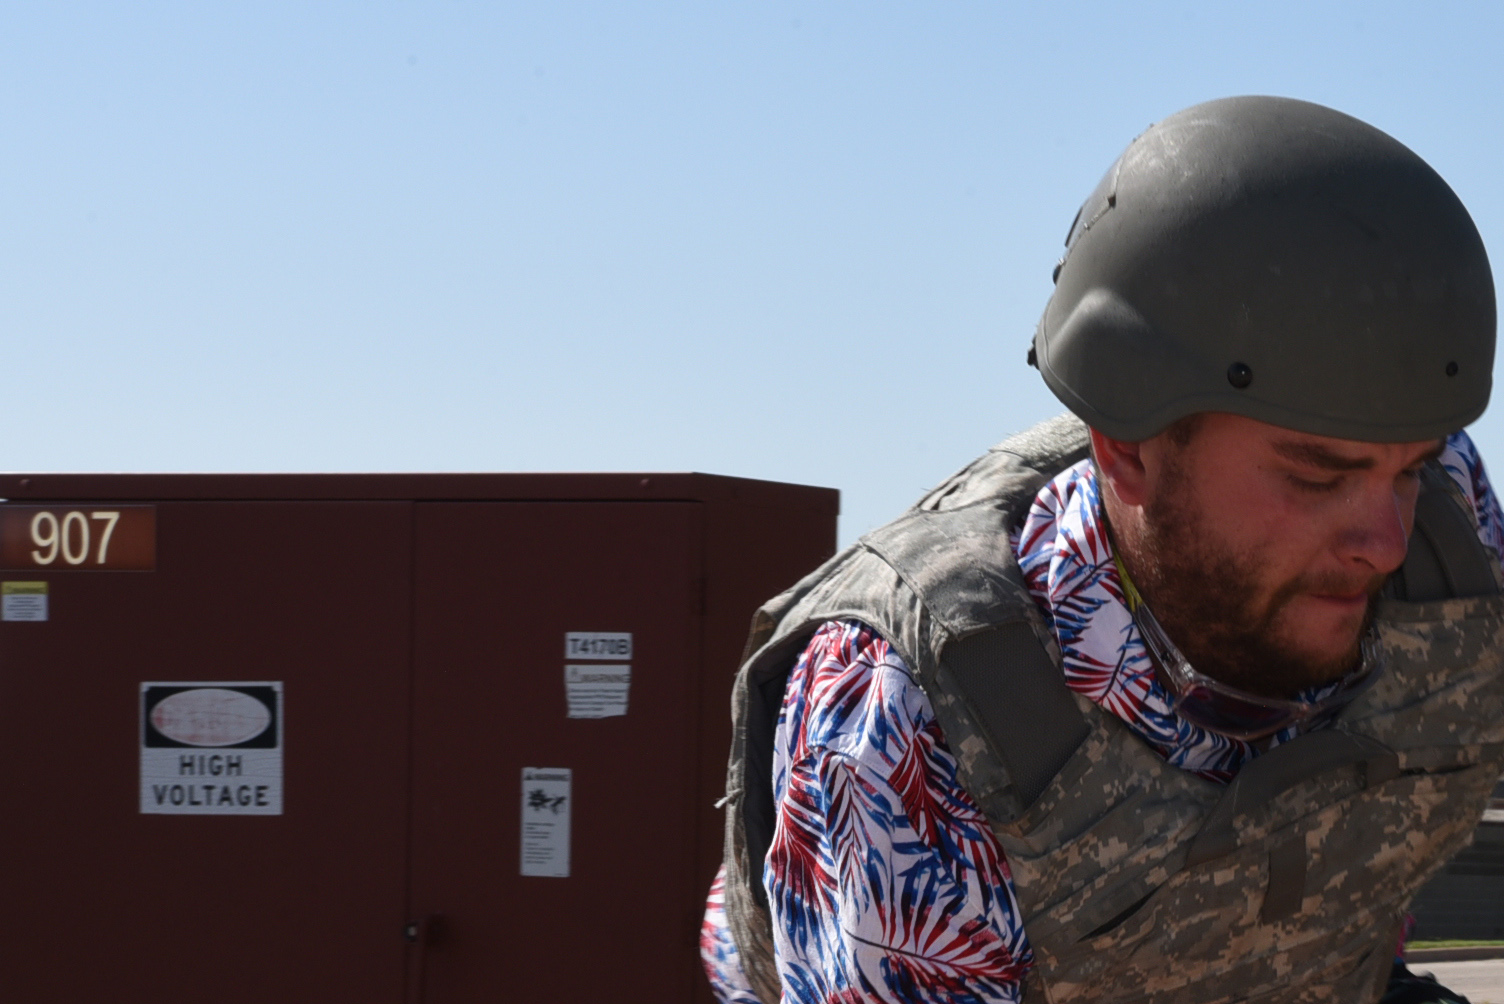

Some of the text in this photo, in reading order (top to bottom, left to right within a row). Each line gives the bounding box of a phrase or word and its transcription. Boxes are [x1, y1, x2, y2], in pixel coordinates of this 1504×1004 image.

[31, 511, 120, 565] 907
[569, 638, 630, 655] T4170B
[179, 754, 243, 776] HIGH
[152, 784, 270, 807] VOLTAGE
